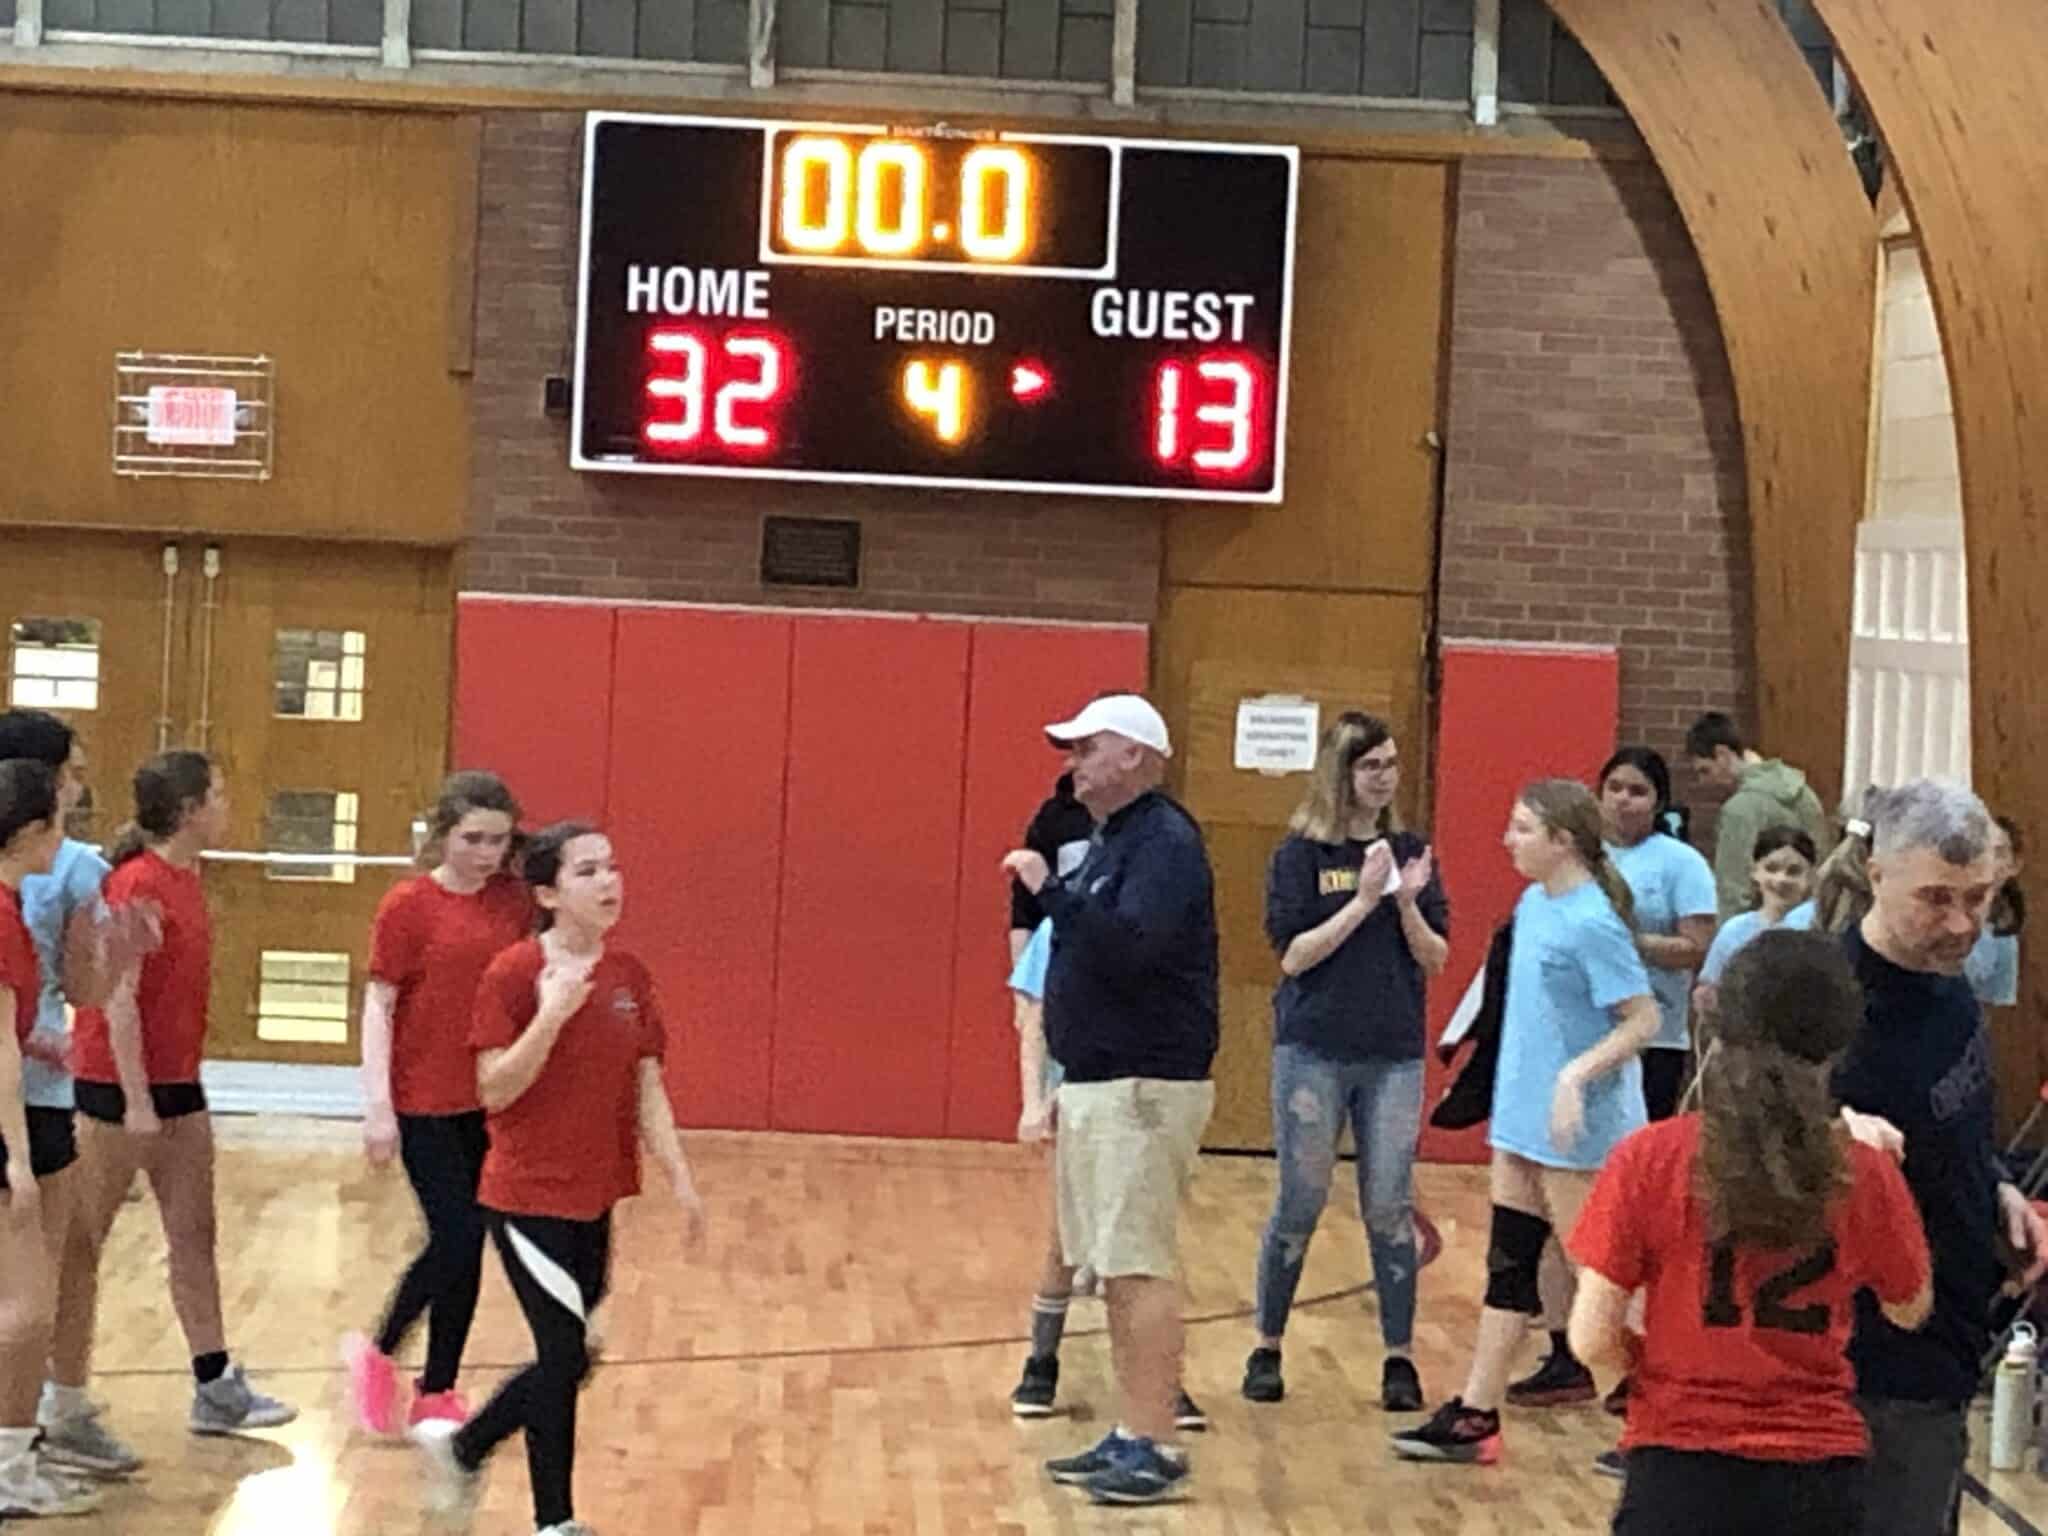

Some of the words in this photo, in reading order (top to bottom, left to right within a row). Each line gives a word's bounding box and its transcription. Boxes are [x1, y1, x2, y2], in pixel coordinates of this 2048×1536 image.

[781, 138, 1030, 262] 00.0
[627, 265, 770, 319] HOME
[875, 307, 995, 345] PERIOD
[1091, 287, 1255, 342] GUEST
[645, 331, 781, 447] 32
[902, 360, 972, 444] 4
[1156, 359, 1257, 474] 13
[1702, 1235, 1838, 1334] 12
